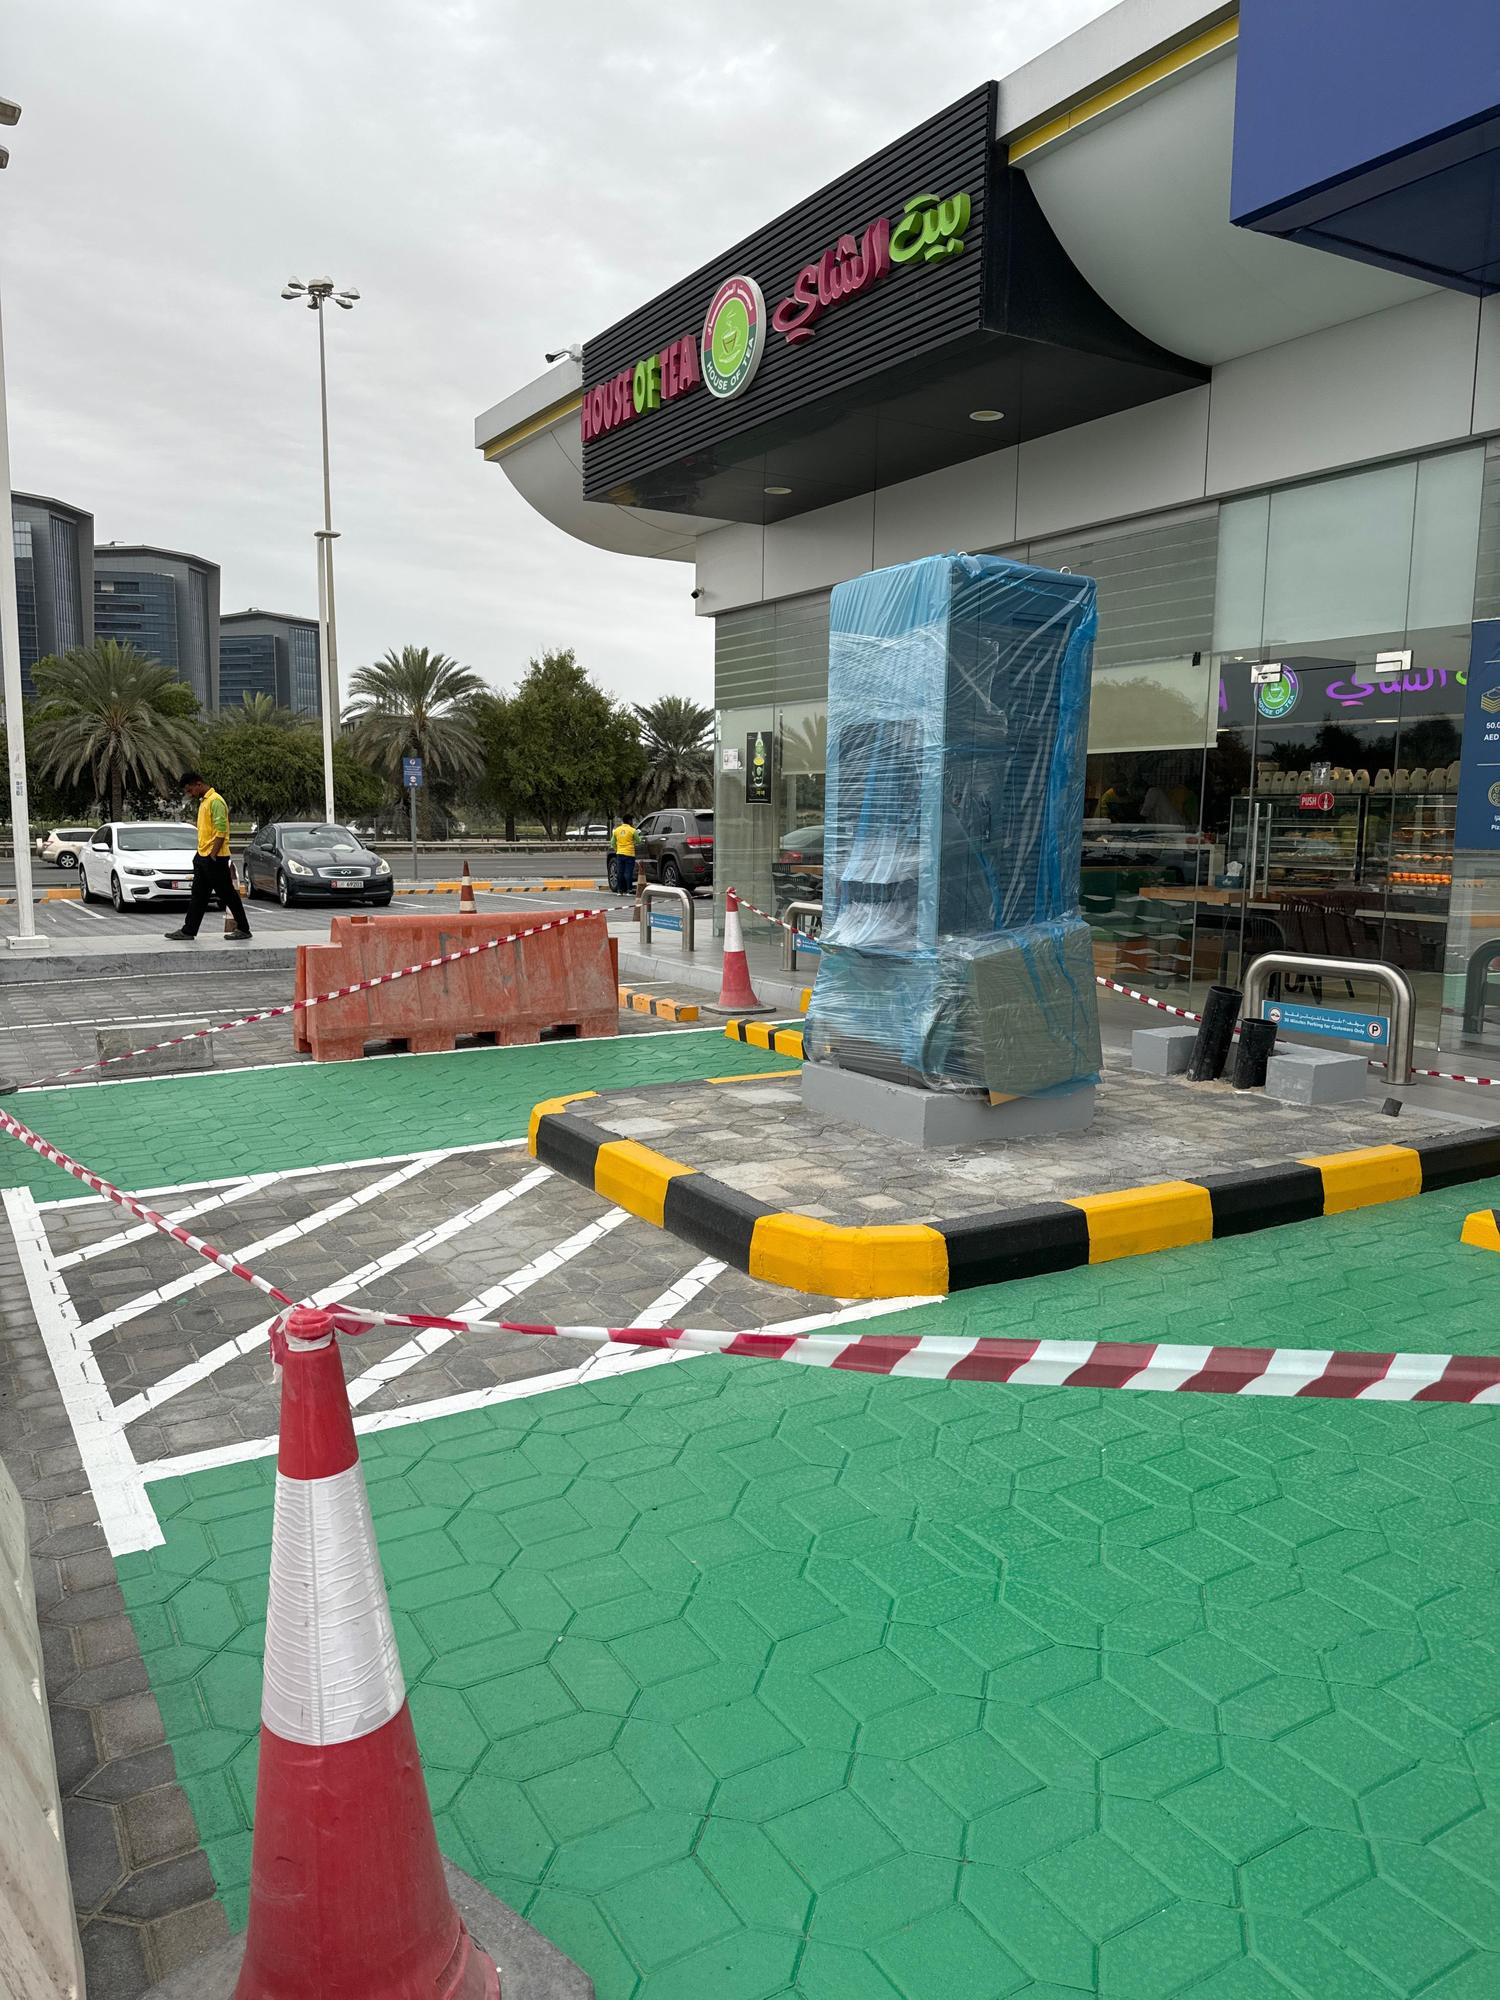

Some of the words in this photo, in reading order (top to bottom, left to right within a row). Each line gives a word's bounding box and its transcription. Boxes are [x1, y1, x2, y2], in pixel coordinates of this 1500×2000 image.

[889, 192, 971, 263] بيت
[772, 217, 890, 344] الشاي
[707, 362, 728, 390] HOUSE
[730, 370, 741, 385] OF
[743, 337, 754, 366] TEA
[581, 368, 635, 442] HOUSE
[633, 354, 660, 415] OF
[660, 335, 700, 400] TEA
[1284, 695, 1295, 708] TEA
[1483, 733, 1500, 741] AED
[1301, 796, 1317, 806] PUSH
[1306, 1020, 1324, 1029] Parking
[1331, 1024, 1354, 1033] Customers
[1354, 1027, 1365, 1036] Only
[1371, 1025, 1379, 1034] P
